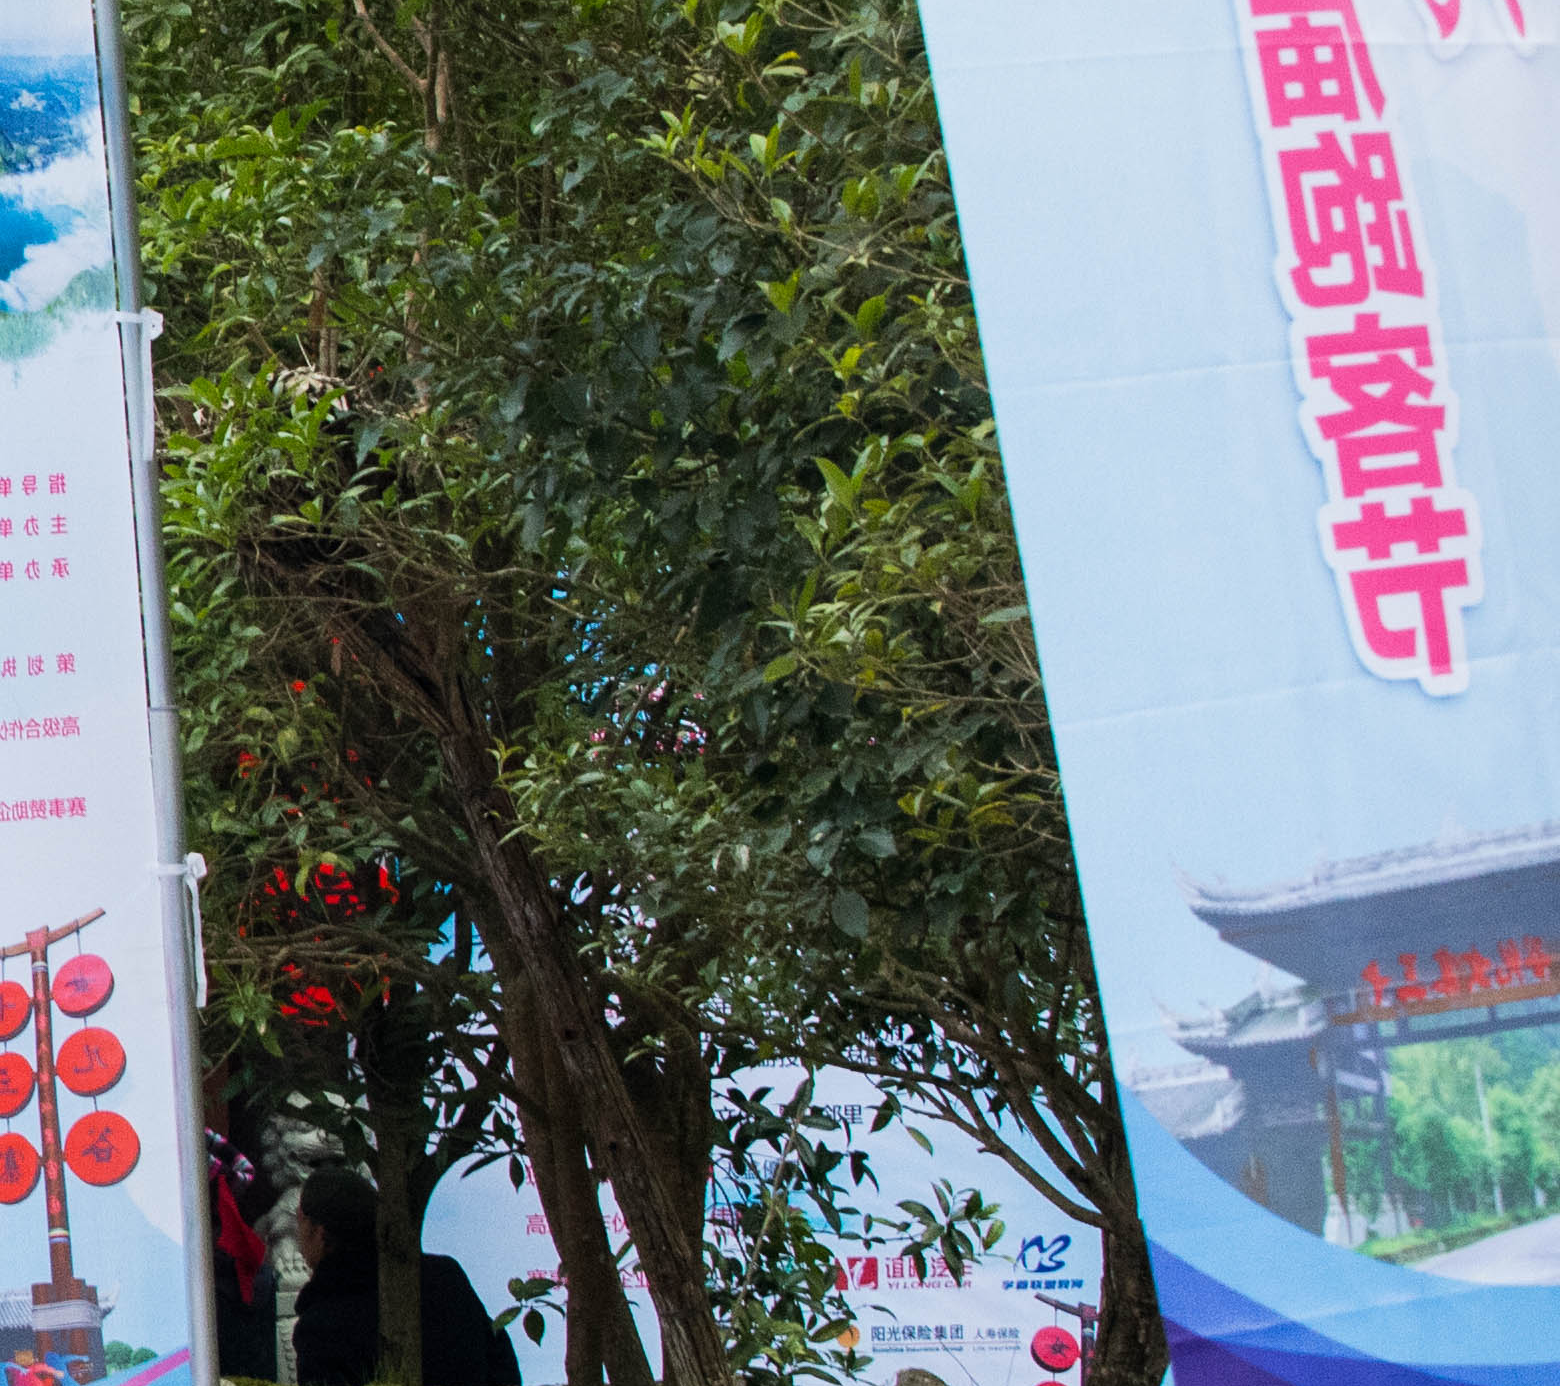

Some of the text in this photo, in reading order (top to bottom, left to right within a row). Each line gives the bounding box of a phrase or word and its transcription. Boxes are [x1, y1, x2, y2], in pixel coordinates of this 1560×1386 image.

[871, 1324, 965, 1341] 阳光保险集团
